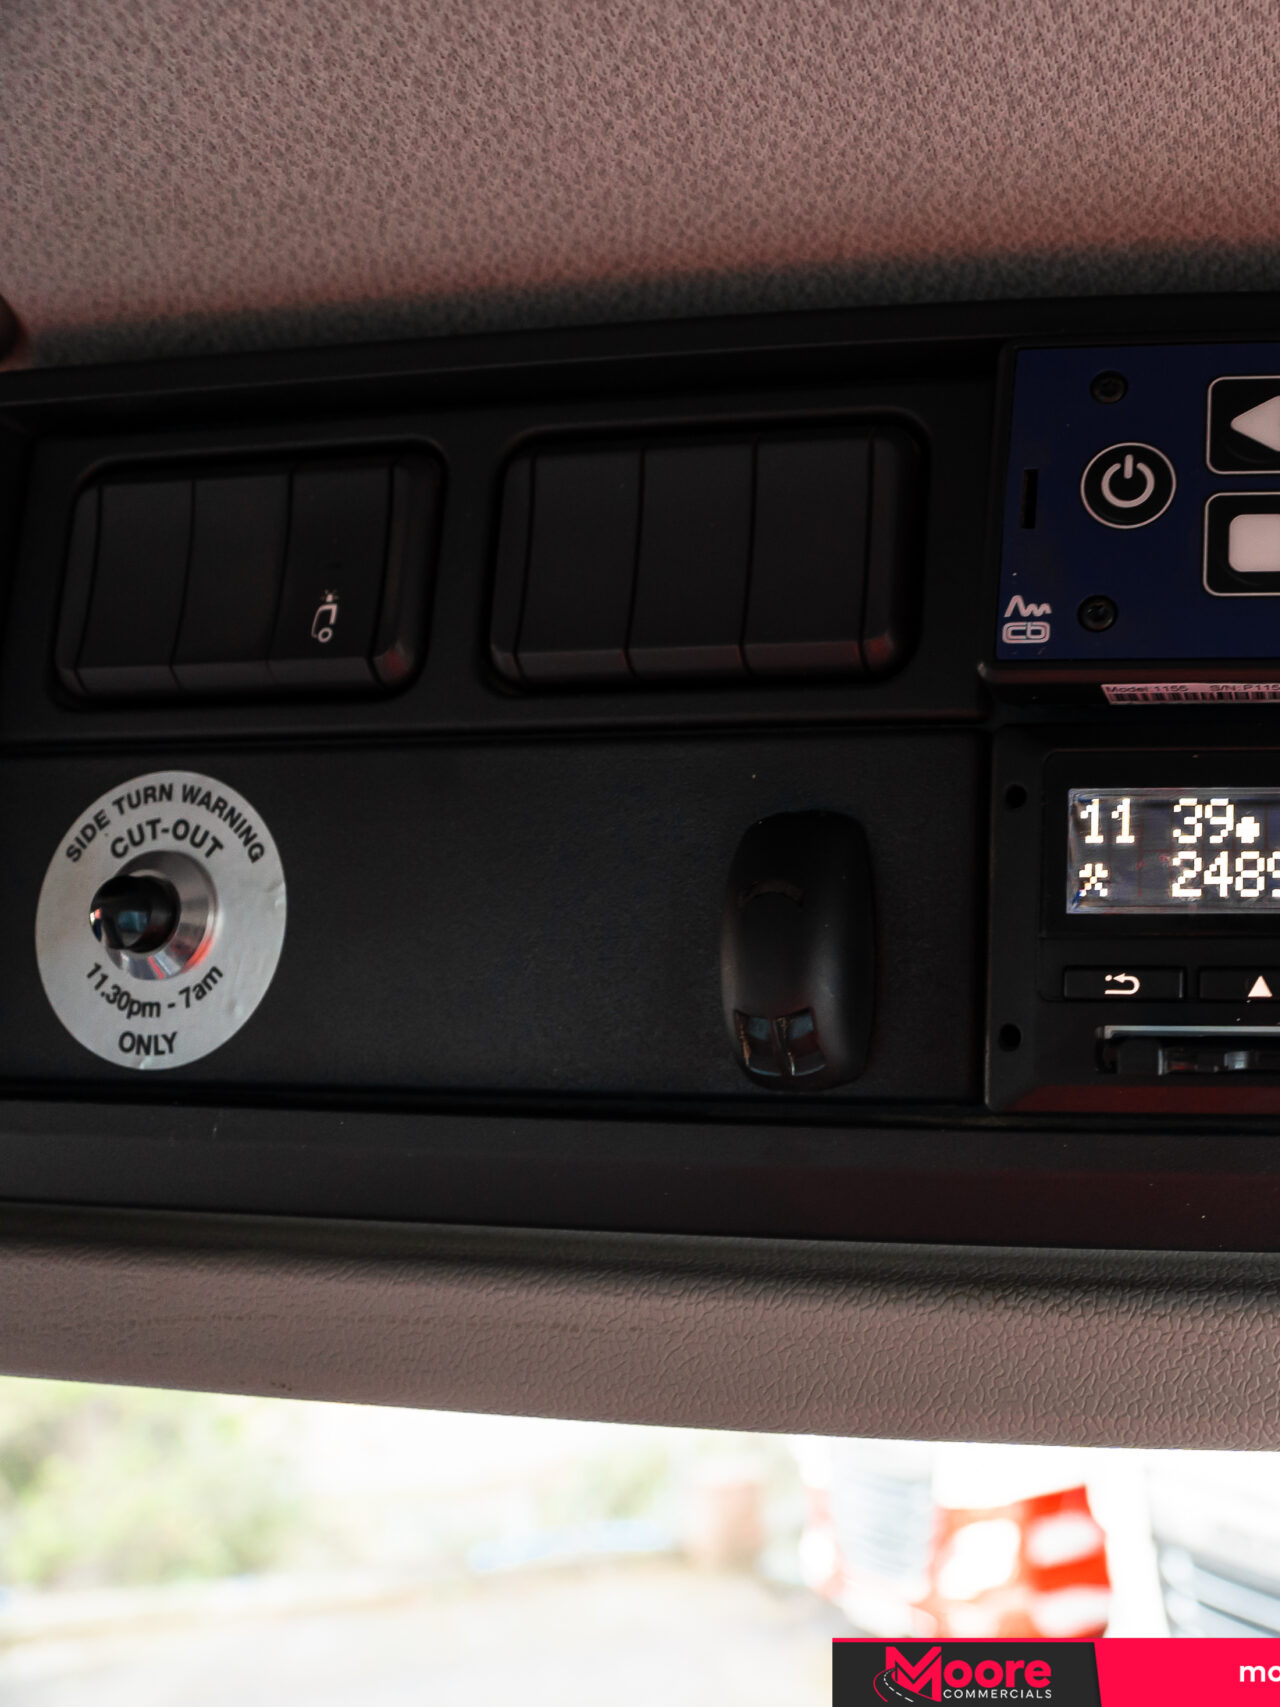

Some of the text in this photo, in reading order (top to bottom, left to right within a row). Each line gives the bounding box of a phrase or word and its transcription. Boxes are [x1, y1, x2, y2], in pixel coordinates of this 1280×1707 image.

[65, 783, 265, 863] SIDE TURN WARNING
[110, 817, 224, 859] CUT-OUT
[85, 962, 161, 1019] 11.30pm
[178, 965, 224, 1009] 7am
[118, 1030, 178, 1056] ONLY
